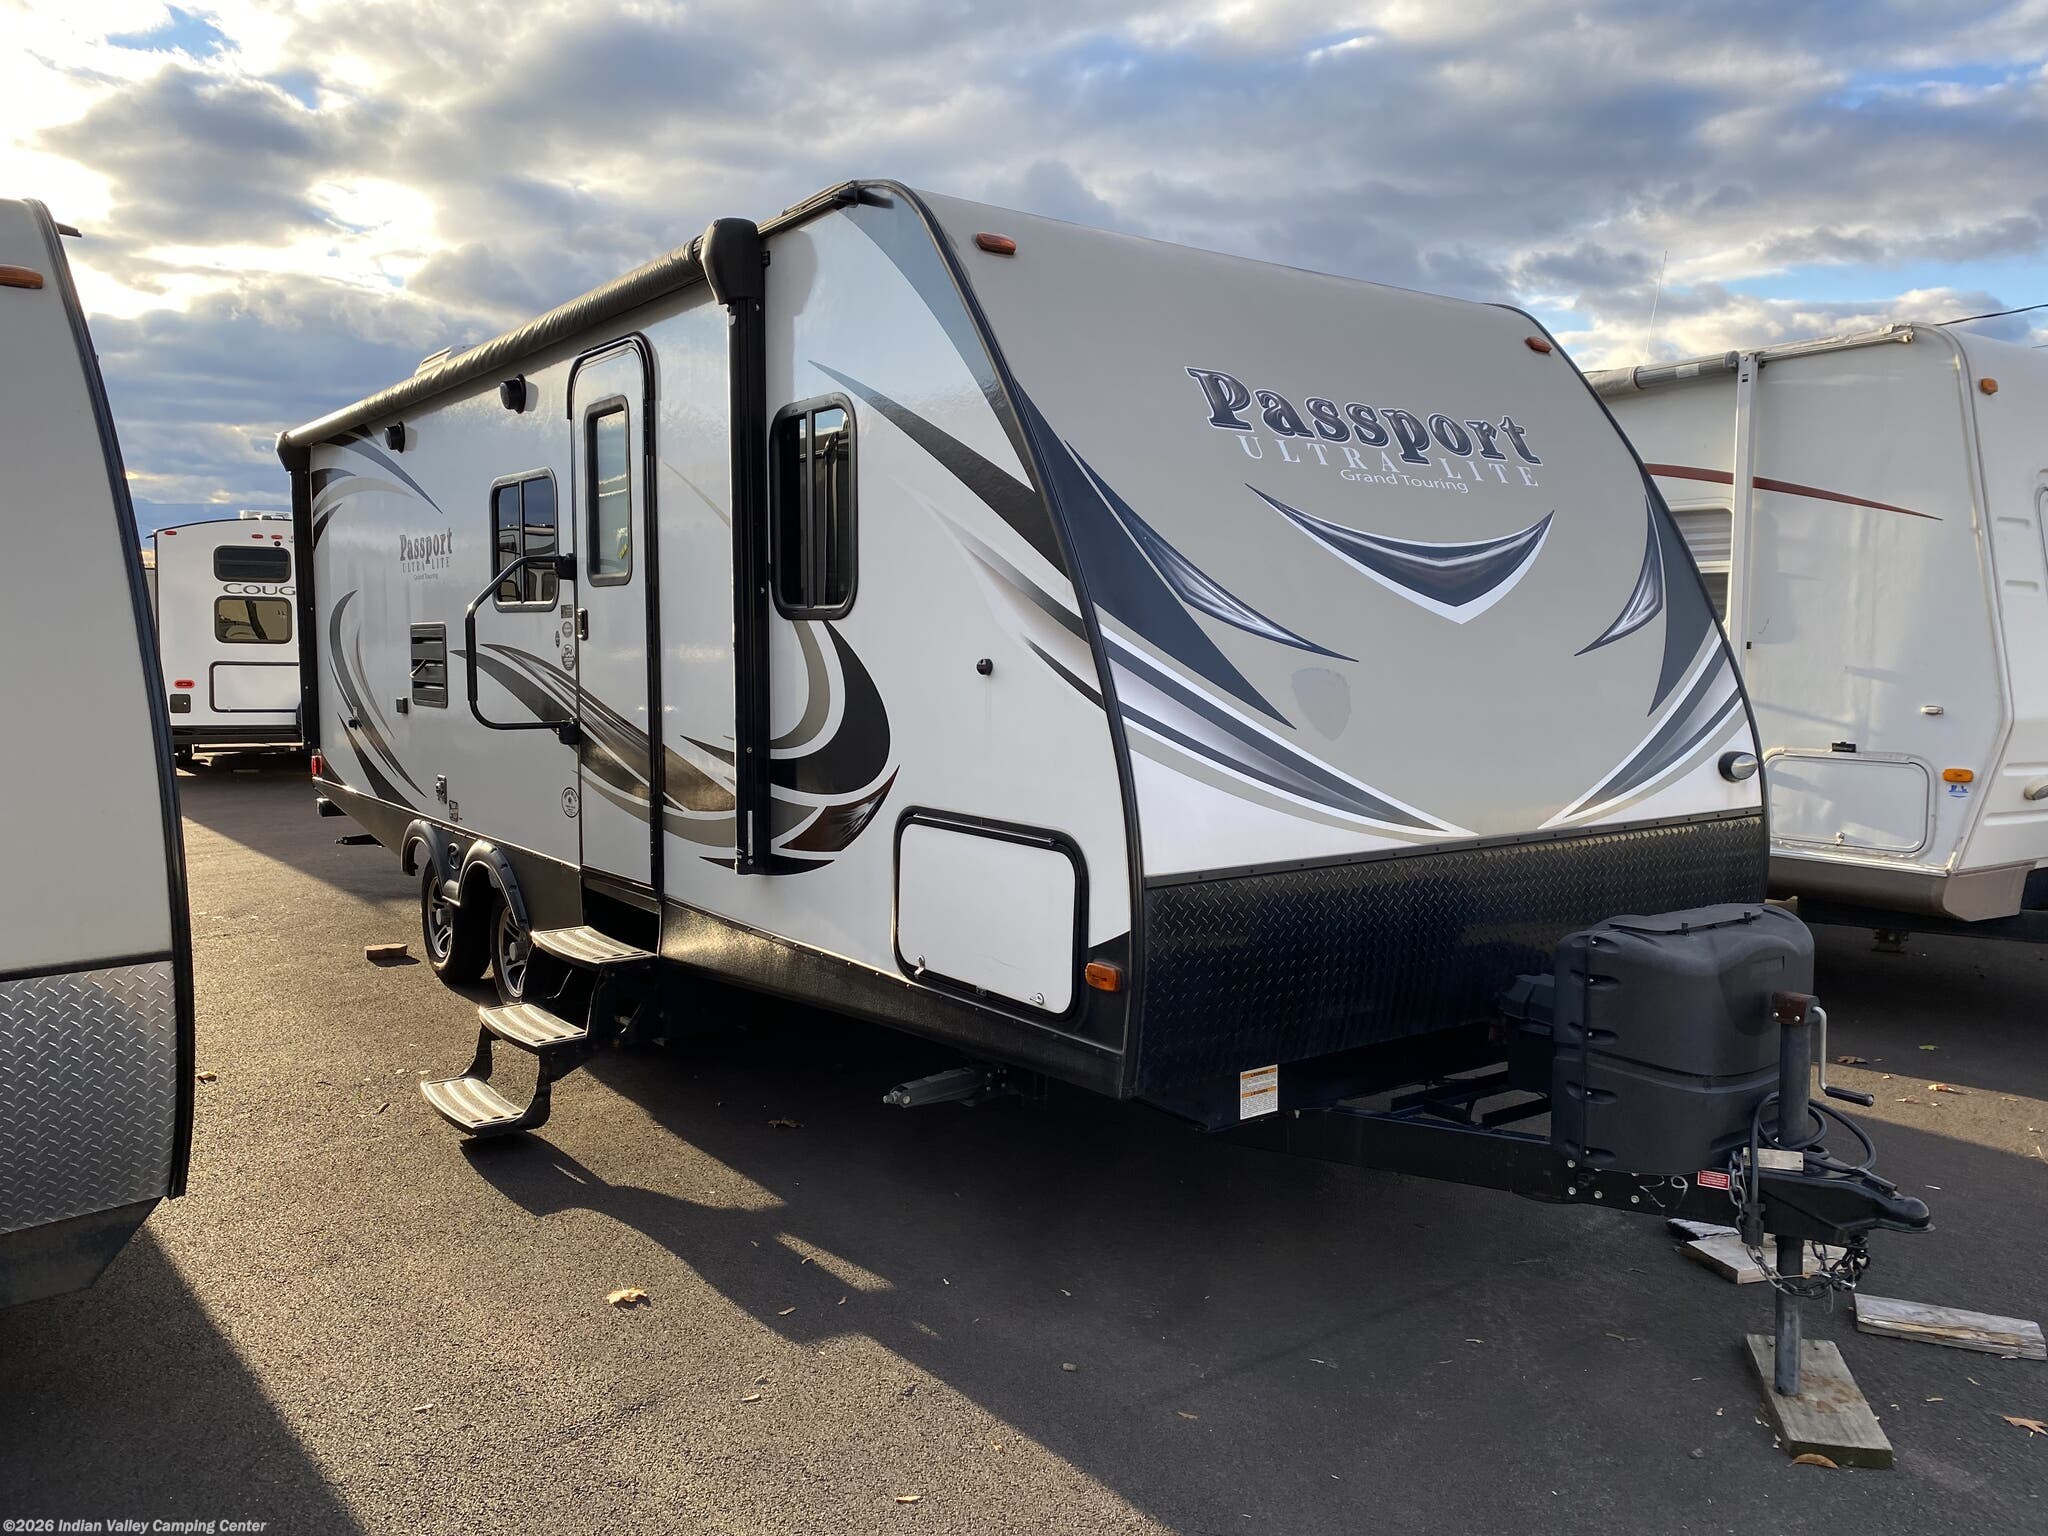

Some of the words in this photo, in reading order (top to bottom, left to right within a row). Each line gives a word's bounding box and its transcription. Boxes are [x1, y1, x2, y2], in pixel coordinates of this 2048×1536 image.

[1184, 366, 1544, 467] Passport
[1236, 434, 1400, 473] ULTRA
[1438, 457, 1540, 488] LITE
[1340, 468, 1398, 486] Grand
[1402, 474, 1469, 494] Touring
[400, 528, 453, 564] Passport
